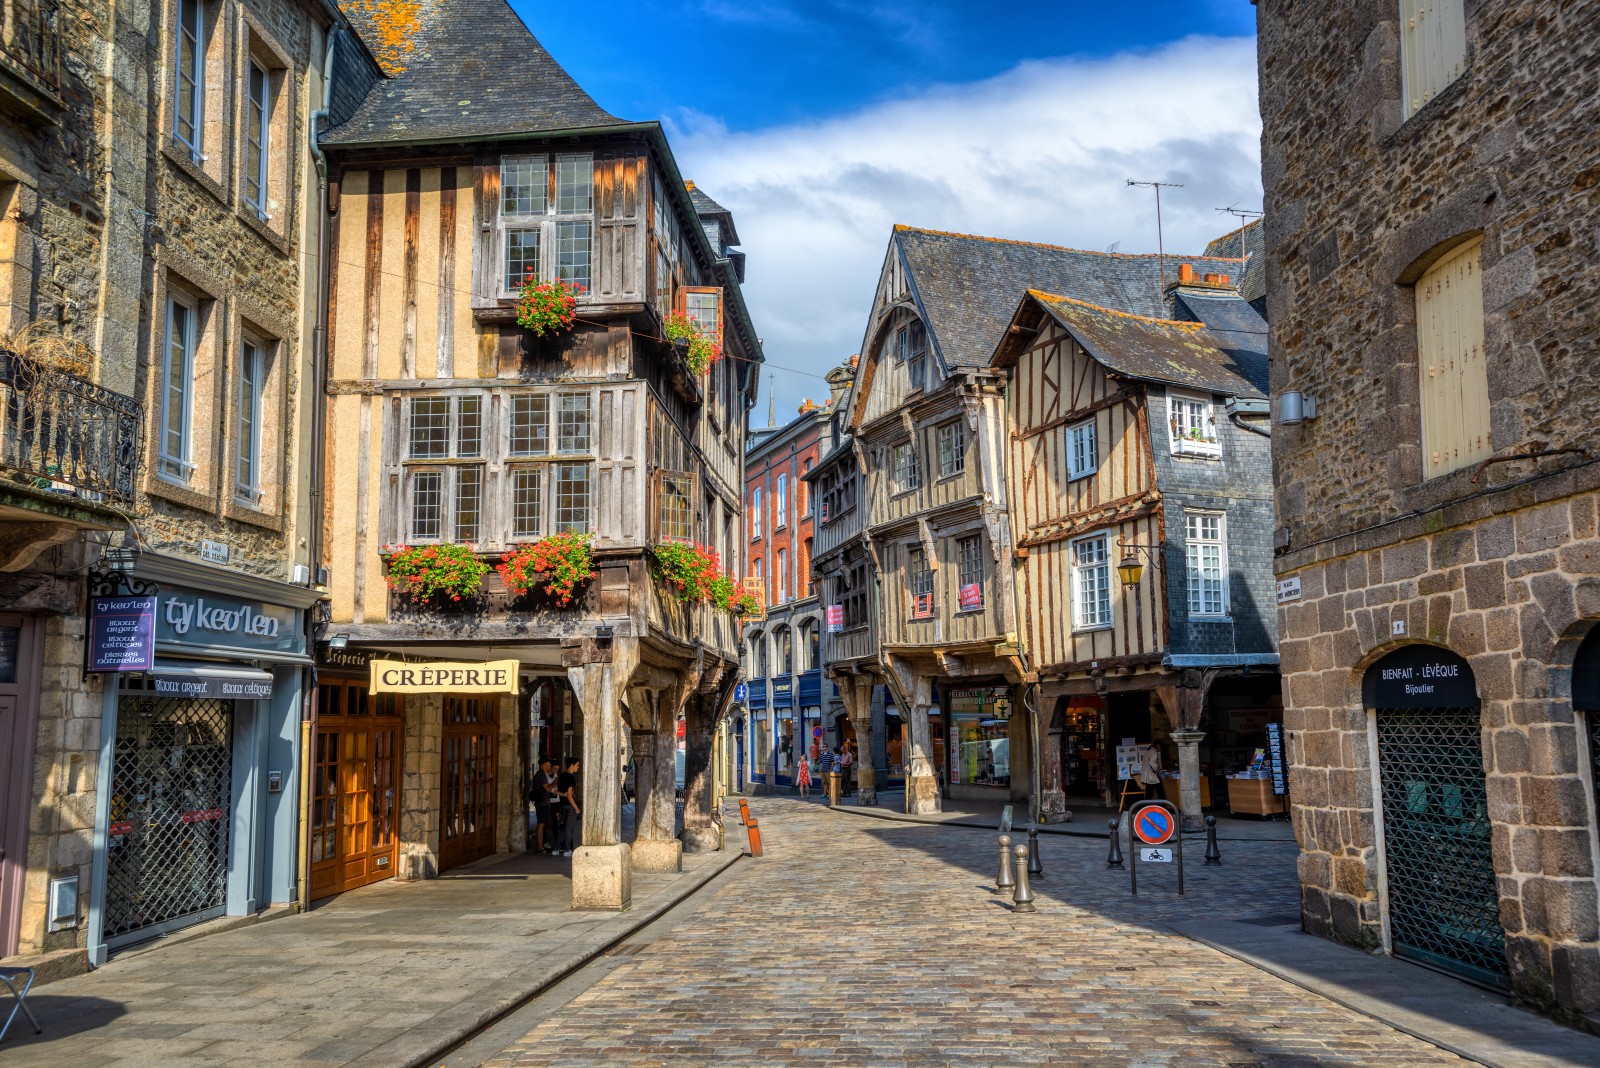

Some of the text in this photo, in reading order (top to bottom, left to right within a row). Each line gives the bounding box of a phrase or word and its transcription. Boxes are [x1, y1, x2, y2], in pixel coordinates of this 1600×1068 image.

[97, 602, 110, 612] ty
[164, 596, 195, 634] ty
[382, 666, 507, 686] CRÊPERIE
[1382, 667, 1413, 680] BIENFAIT
[1422, 662, 1459, 678] LÉVÊQUE
[1405, 683, 1435, 696] Bijoutier
